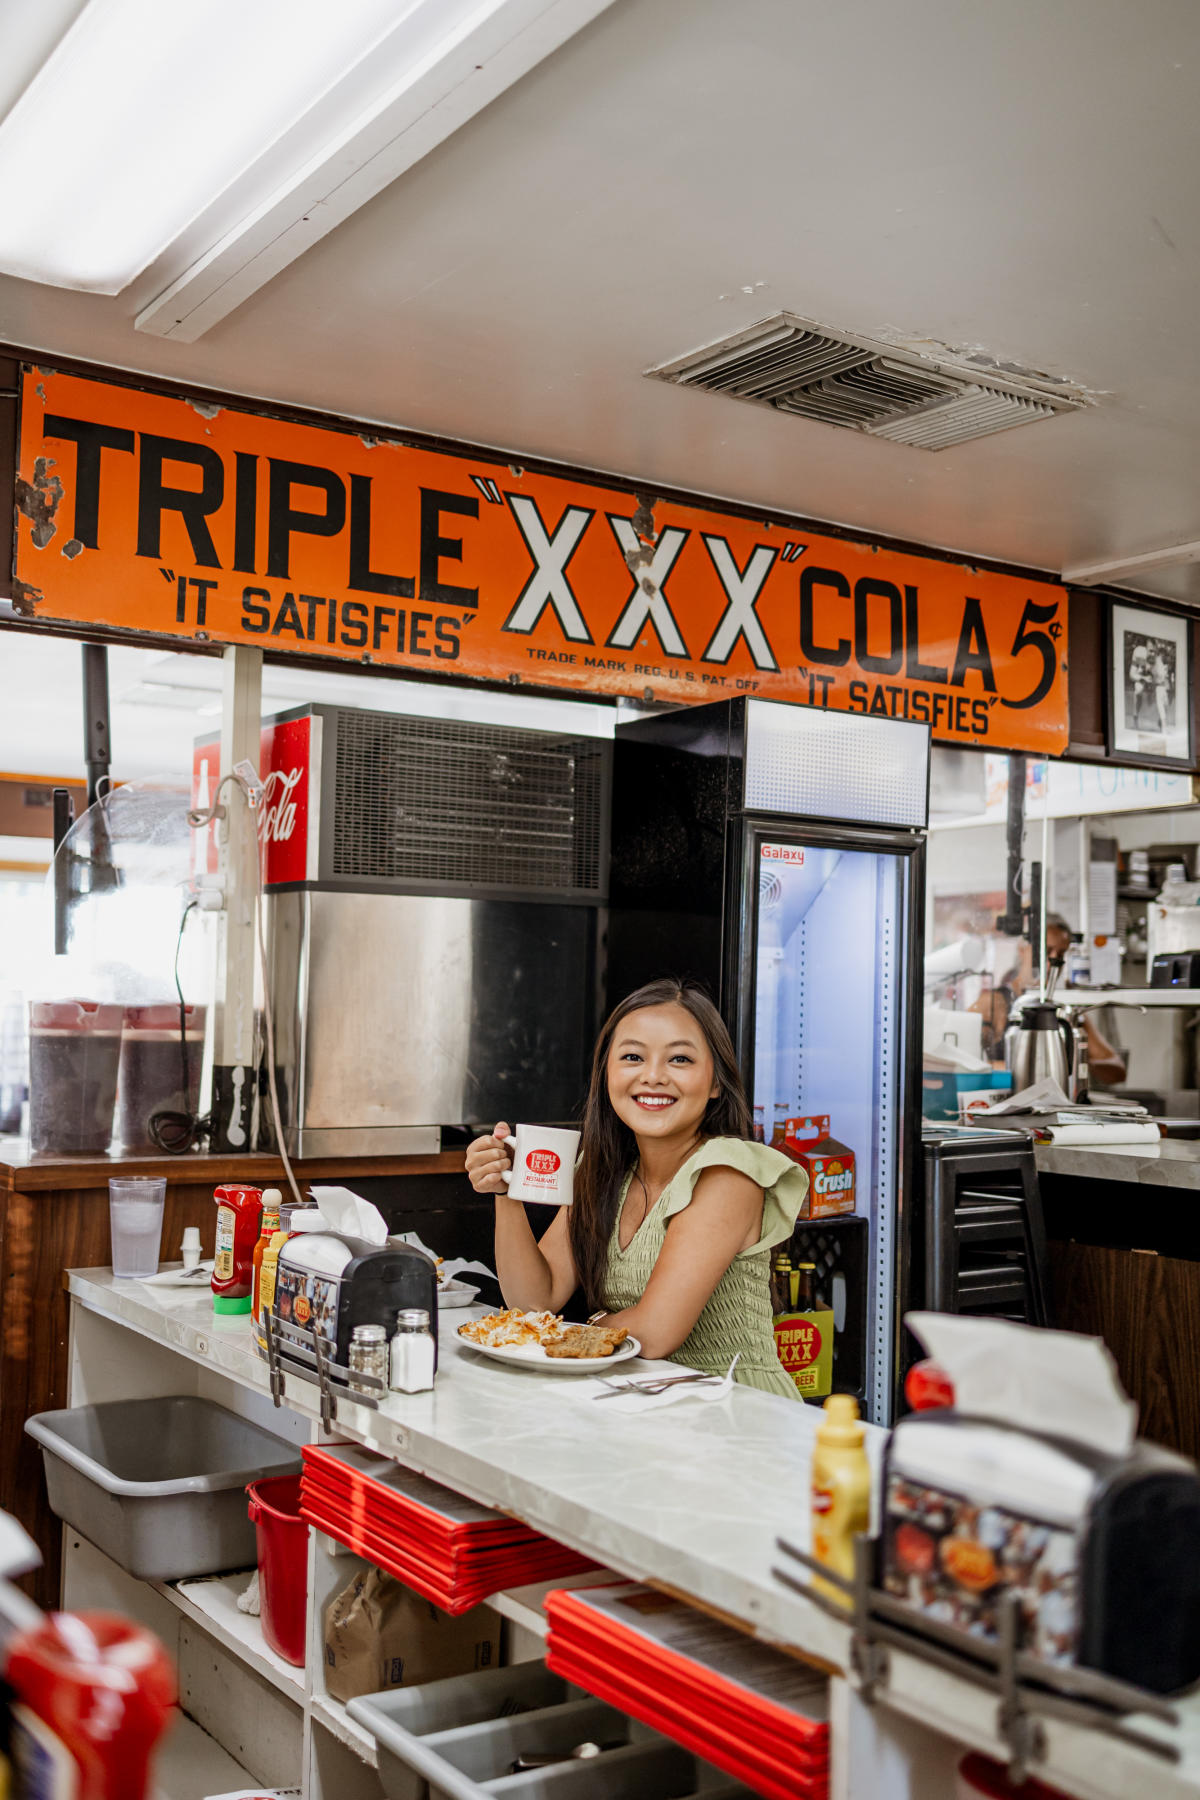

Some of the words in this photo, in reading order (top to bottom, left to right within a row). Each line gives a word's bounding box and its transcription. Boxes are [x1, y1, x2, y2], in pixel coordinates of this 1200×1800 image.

[43, 413, 480, 609] TRIPLE
[800, 566, 998, 693] COLA
[526, 647, 577, 666] TRADE
[584, 656, 626, 673] MARK
[761, 846, 804, 865] Galaxy
[814, 1169, 853, 1194] Crush
[779, 1343, 813, 1362] XXX
